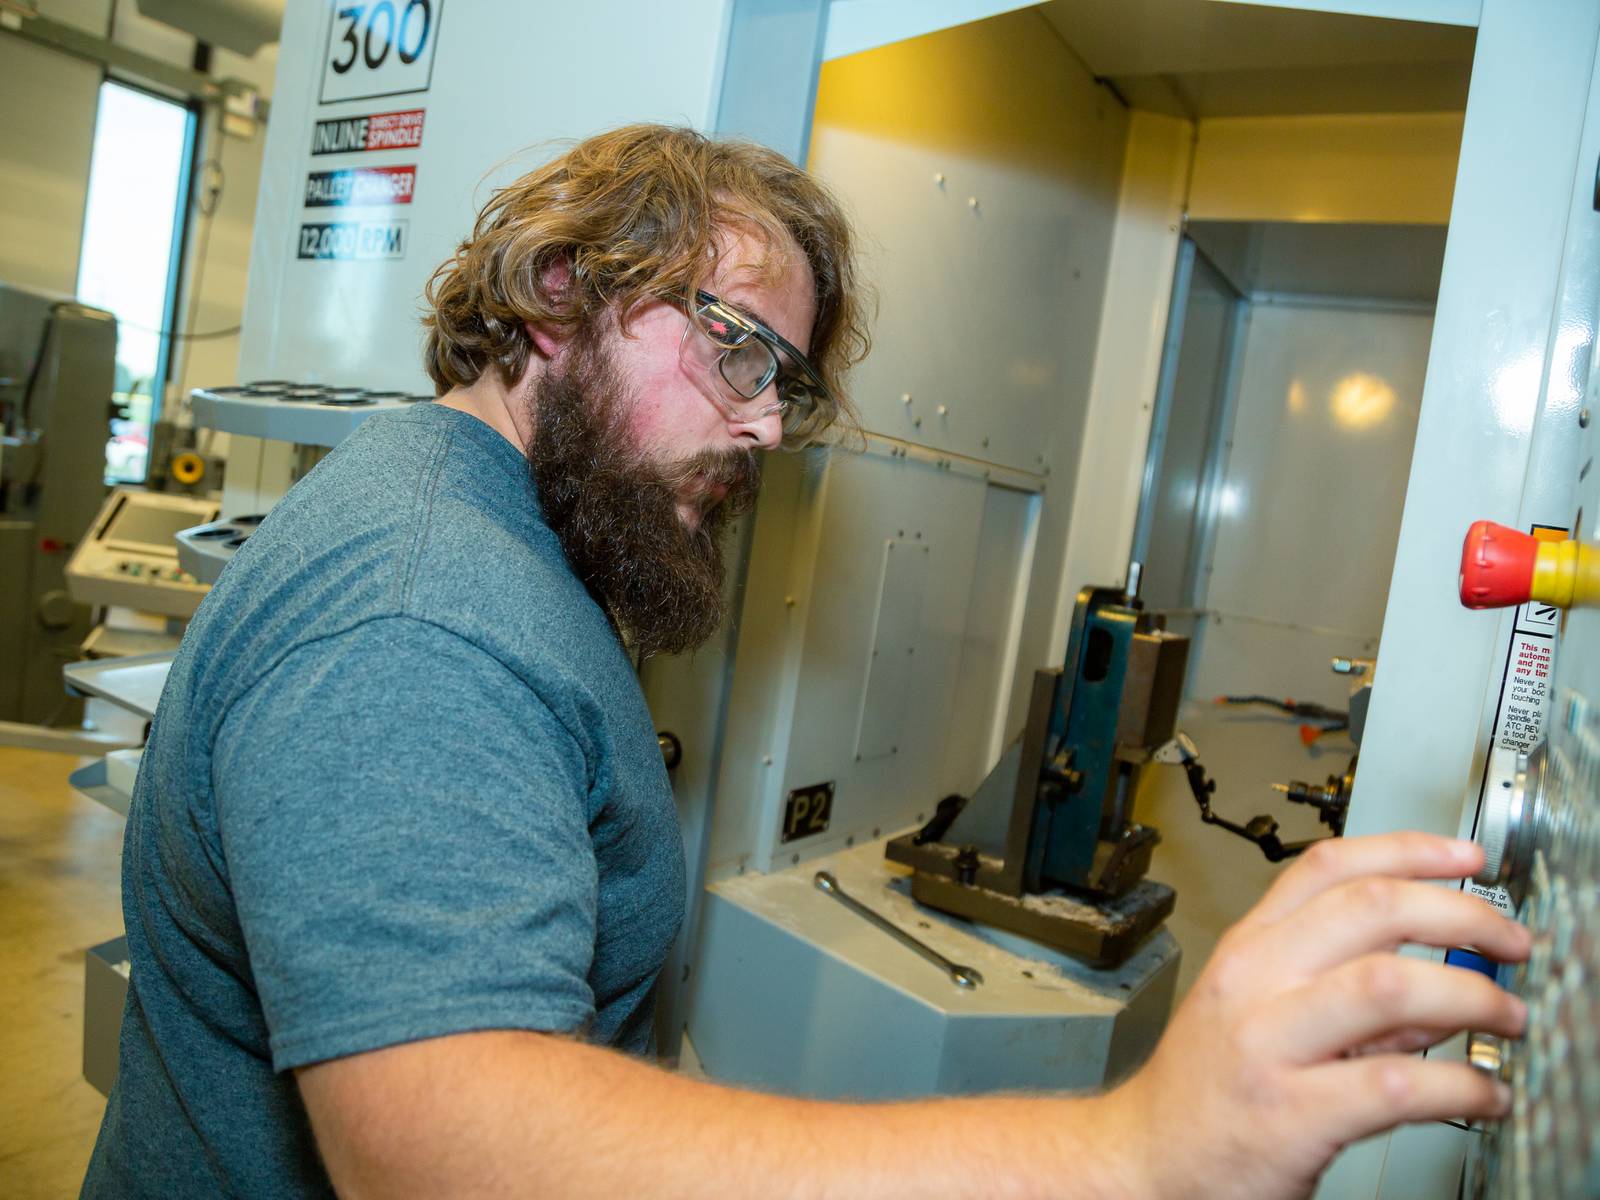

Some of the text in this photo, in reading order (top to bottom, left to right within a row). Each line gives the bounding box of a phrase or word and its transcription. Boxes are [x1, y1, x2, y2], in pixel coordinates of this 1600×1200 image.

[332, 0, 431, 74] 300
[312, 118, 368, 153] INLINE
[368, 127, 421, 149] SPINDLE
[362, 227, 402, 255] RPM
[1521, 642, 1538, 652] This
[1517, 659, 1533, 667] and
[1516, 667, 1531, 676] any
[1513, 676, 1535, 686] Never
[1511, 693, 1540, 706] touching
[1508, 705, 1529, 715] Never
[1506, 713, 1531, 724] spindle
[1505, 721, 1540, 734] ATC REV
[1512, 731, 1526, 739] tool
[1502, 738, 1530, 749] changer
[790, 791, 827, 834] P2
[1471, 887, 1496, 901] crazing
